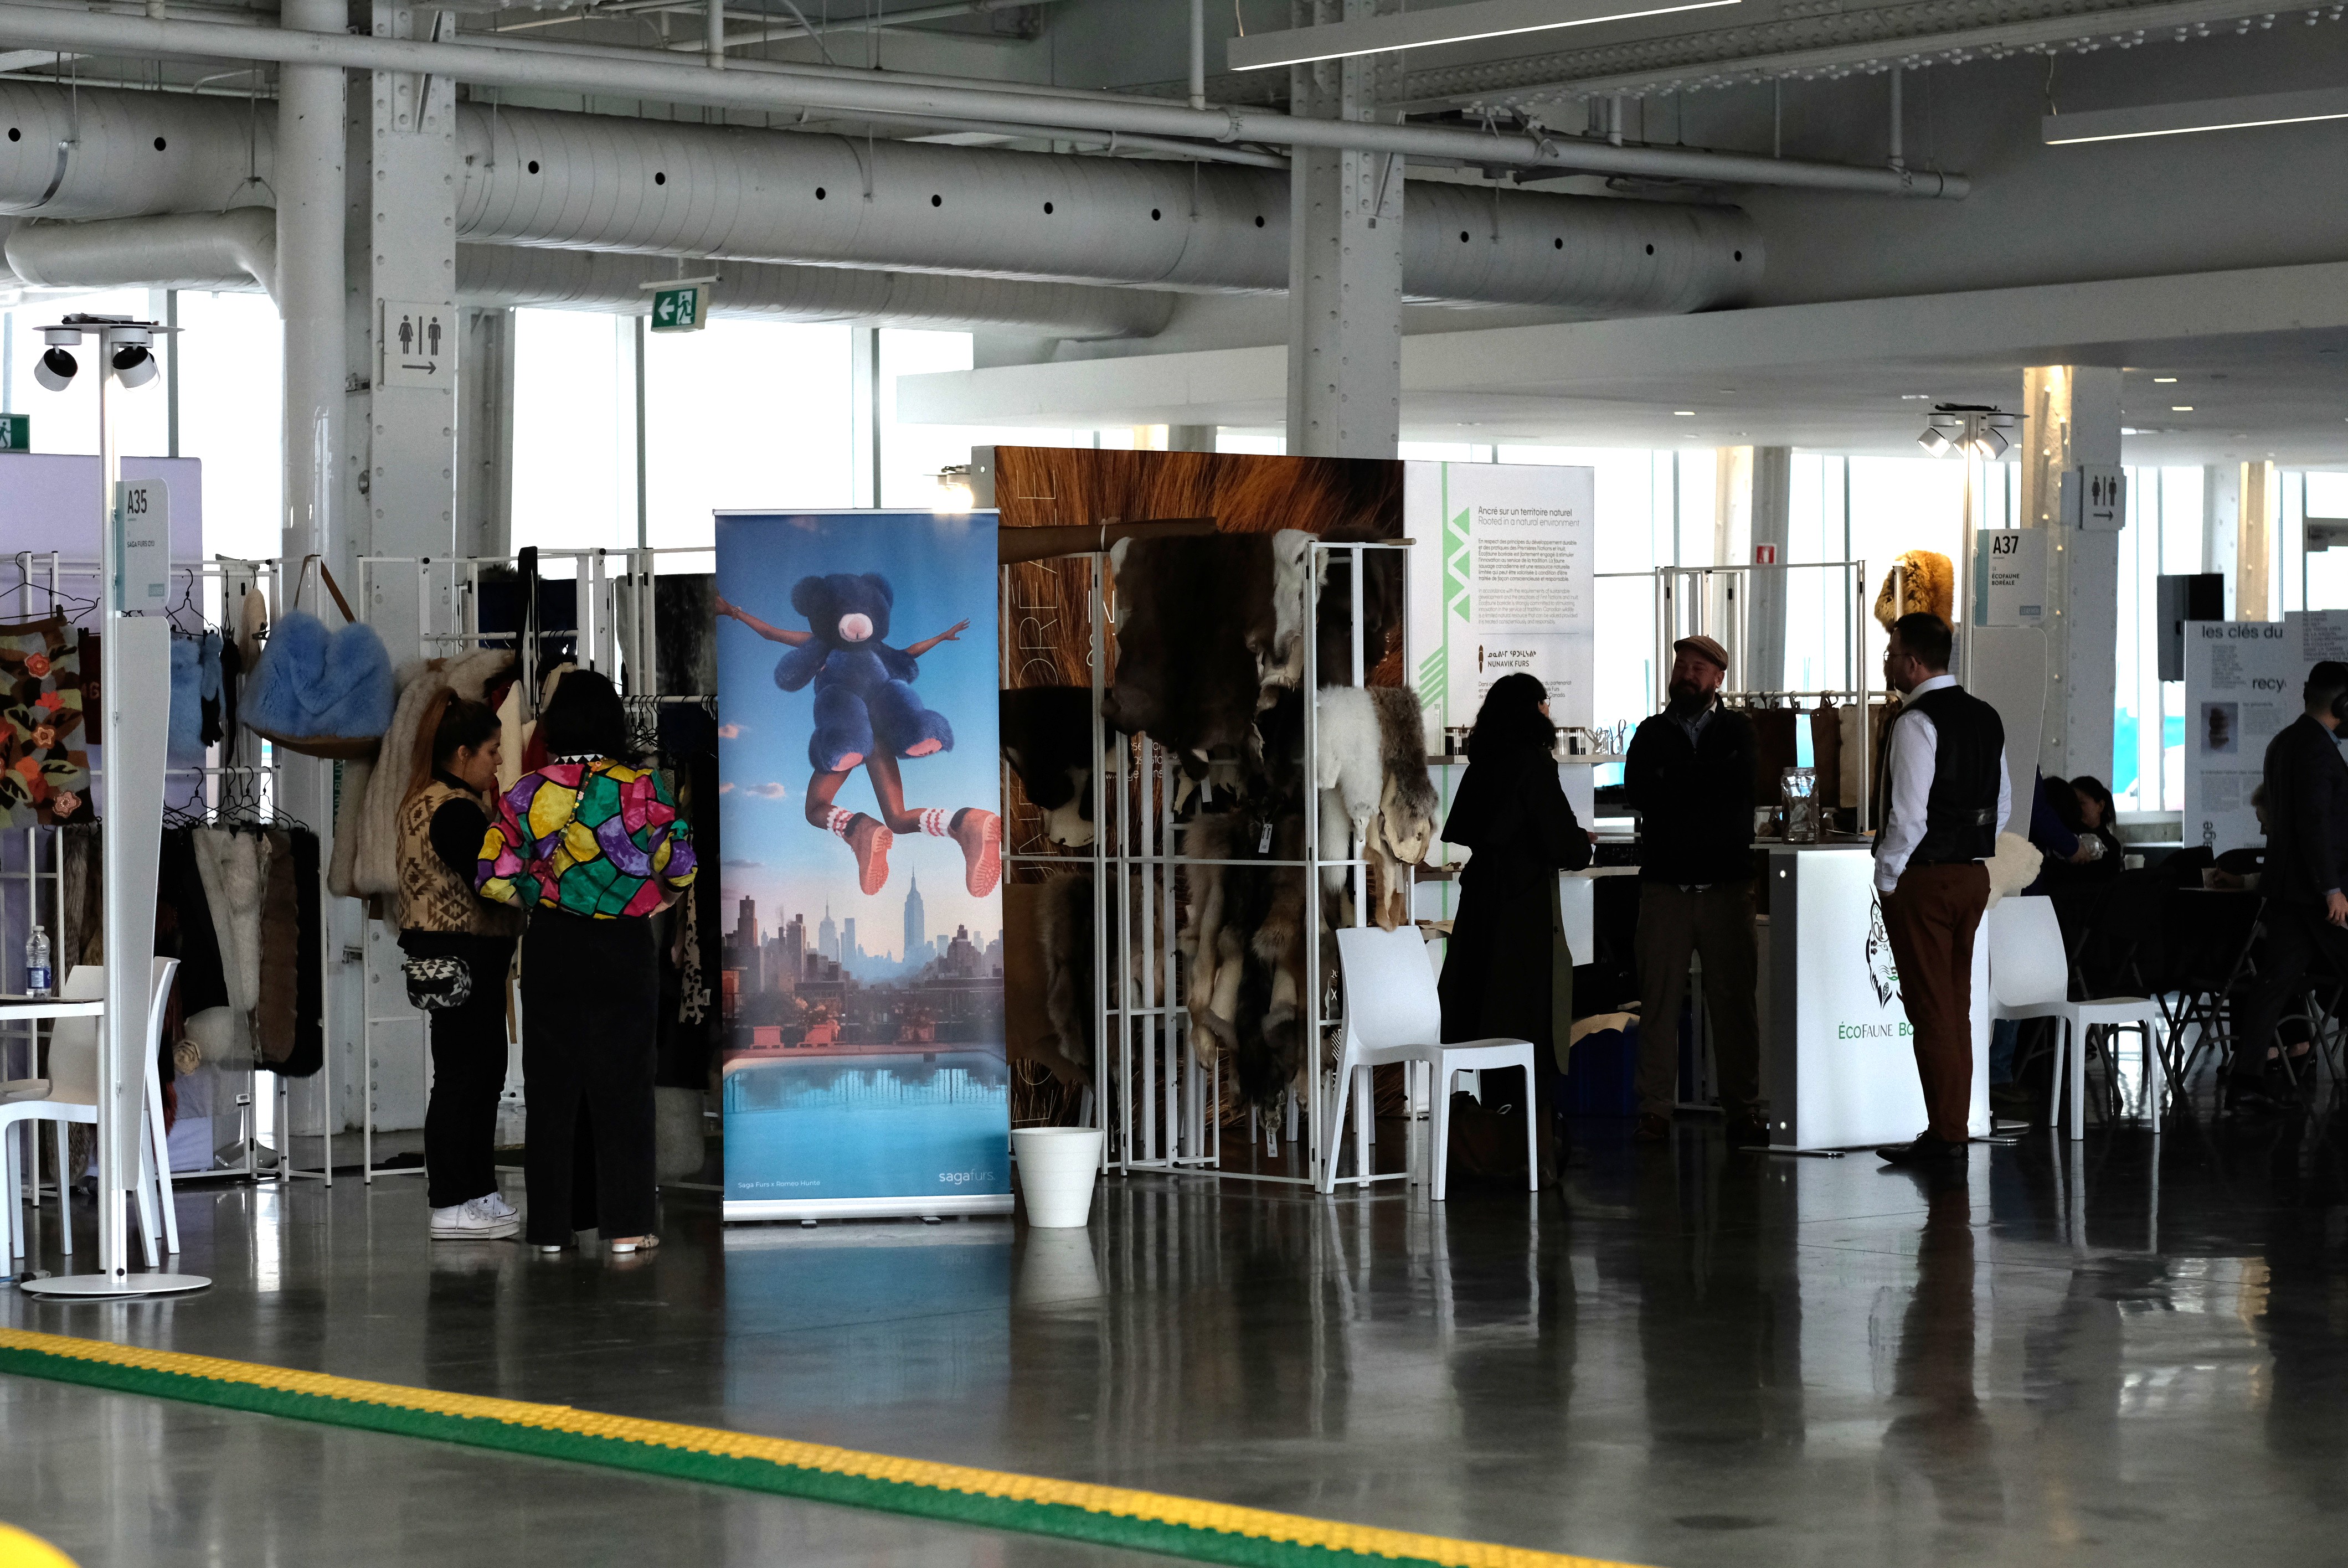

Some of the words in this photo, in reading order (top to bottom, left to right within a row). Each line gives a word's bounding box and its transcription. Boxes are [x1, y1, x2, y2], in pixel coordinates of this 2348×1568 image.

[127, 489, 147, 514] A35
[1478, 506, 1497, 515] Ancré
[1521, 508, 1548, 516] territoire
[1478, 516, 1502, 525] Rooted
[1993, 535, 2019, 554] A37
[2202, 625, 2223, 639] les
[2228, 624, 2259, 639] clés
[2264, 625, 2283, 639] du
[1839, 1021, 1893, 1039] ÉCOFAUNE
